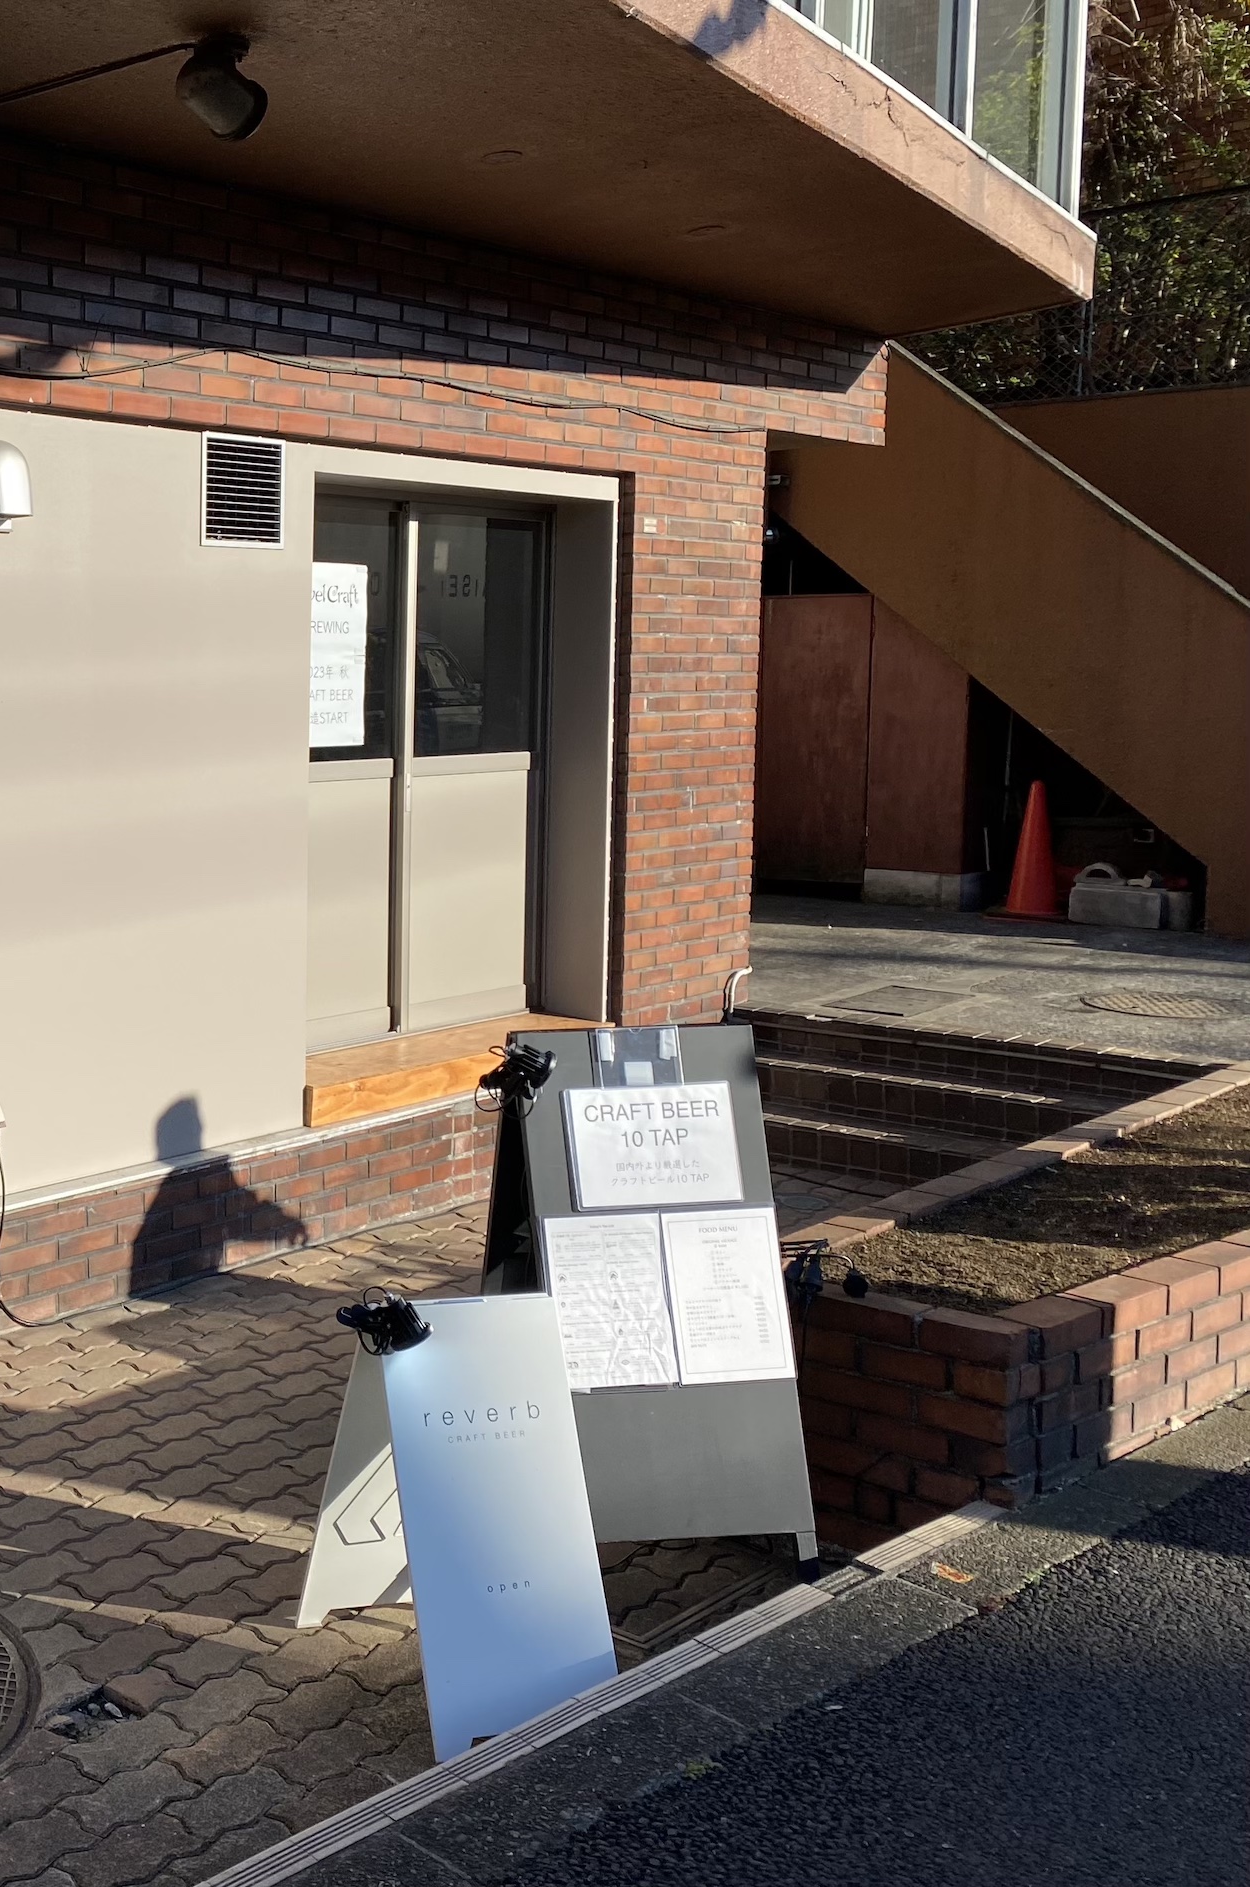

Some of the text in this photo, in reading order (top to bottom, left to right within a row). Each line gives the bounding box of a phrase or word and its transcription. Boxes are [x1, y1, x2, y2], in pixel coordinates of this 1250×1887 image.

[338, 664, 350, 680] 秋
[329, 689, 354, 702] BEER
[584, 1099, 720, 1123] CRAFT BEER
[621, 1128, 689, 1148] 10 TAP
[690, 1172, 710, 1183] TAP
[698, 1225, 738, 1234] FOOD MENU
[423, 1400, 541, 1427] reverb
[447, 1429, 527, 1444] CRAFT BEER
[487, 1580, 532, 1594] open
